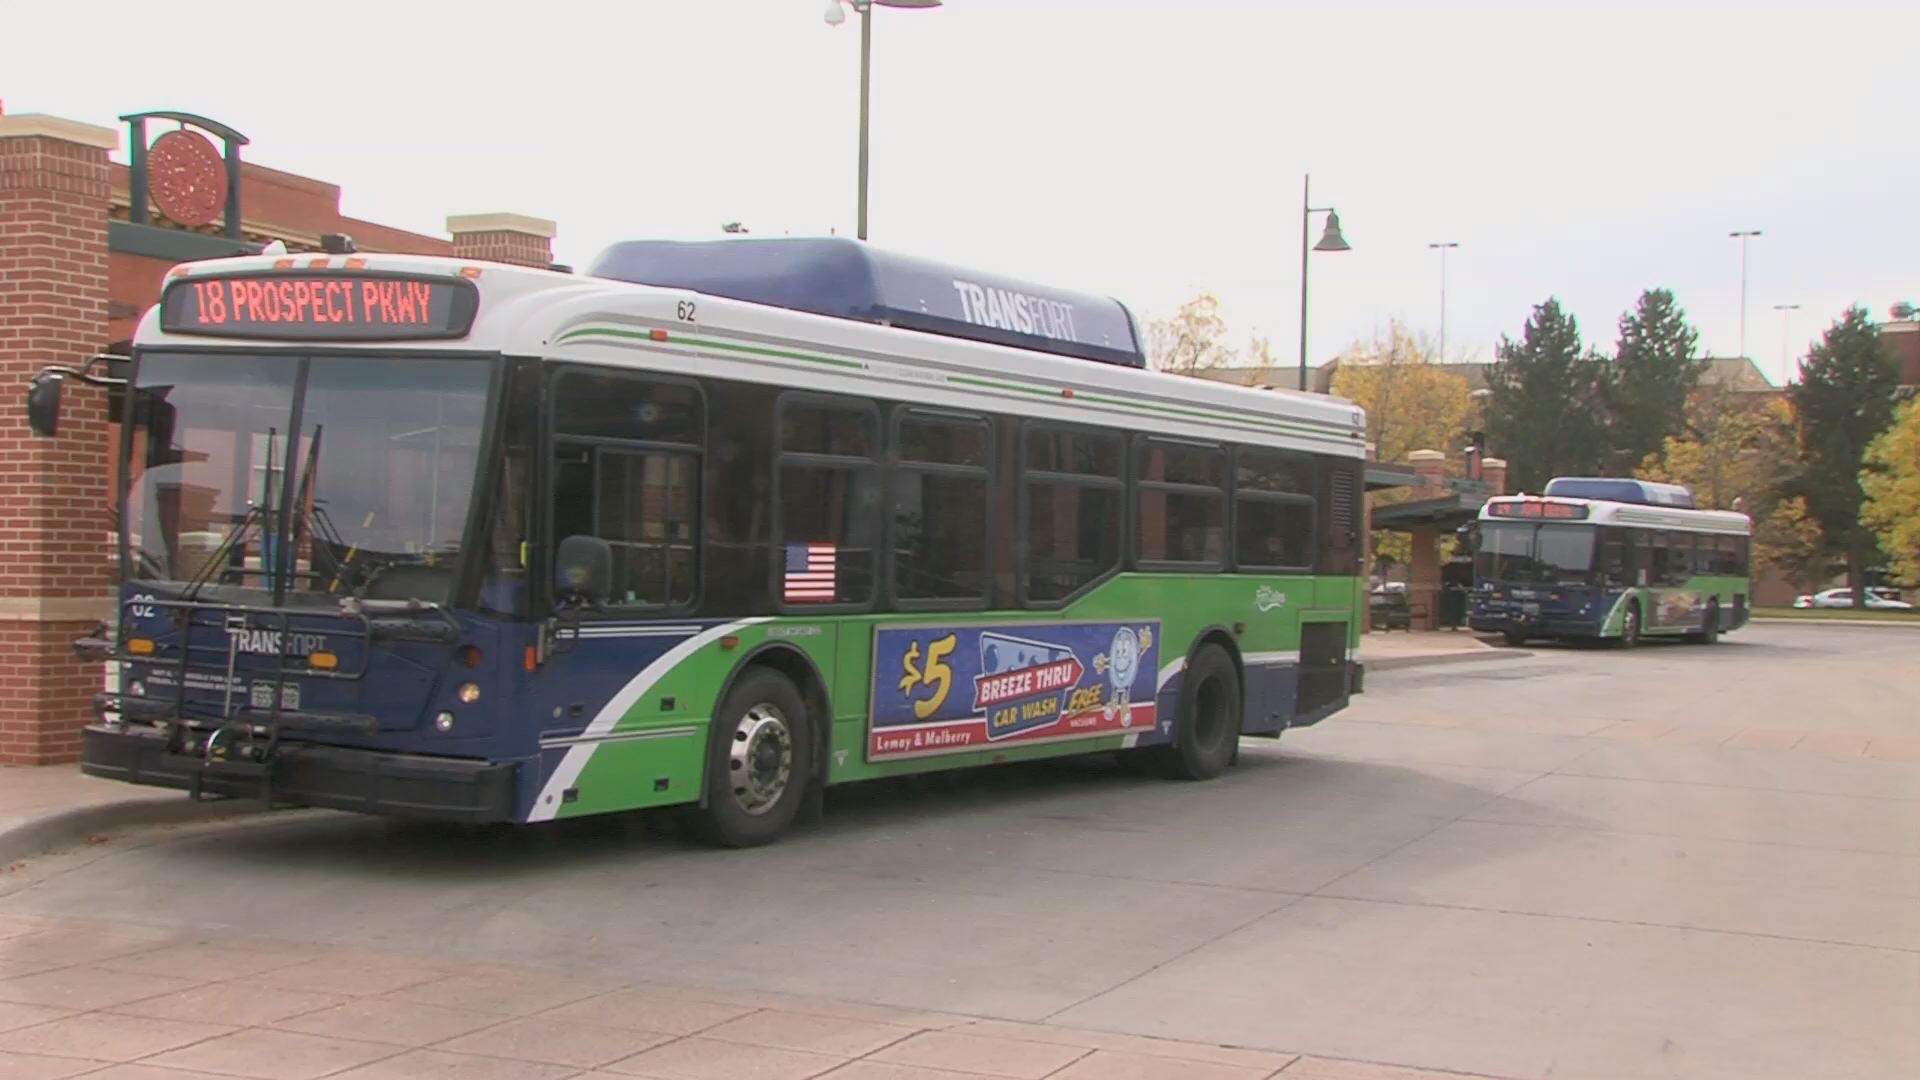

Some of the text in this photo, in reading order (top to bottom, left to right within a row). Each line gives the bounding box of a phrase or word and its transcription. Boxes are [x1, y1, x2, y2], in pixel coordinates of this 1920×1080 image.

[195, 280, 431, 324] 18 PROSPECT PKWY
[677, 300, 696, 323] 62
[952, 280, 1080, 343] TRANSFORT
[898, 632, 958, 721] $5
[980, 662, 1074, 703] BREEZE THRU
[993, 697, 1058, 729] CAR WASH
[1069, 684, 1103, 714] FREE
[877, 729, 971, 751] Lemay & Mulberry
